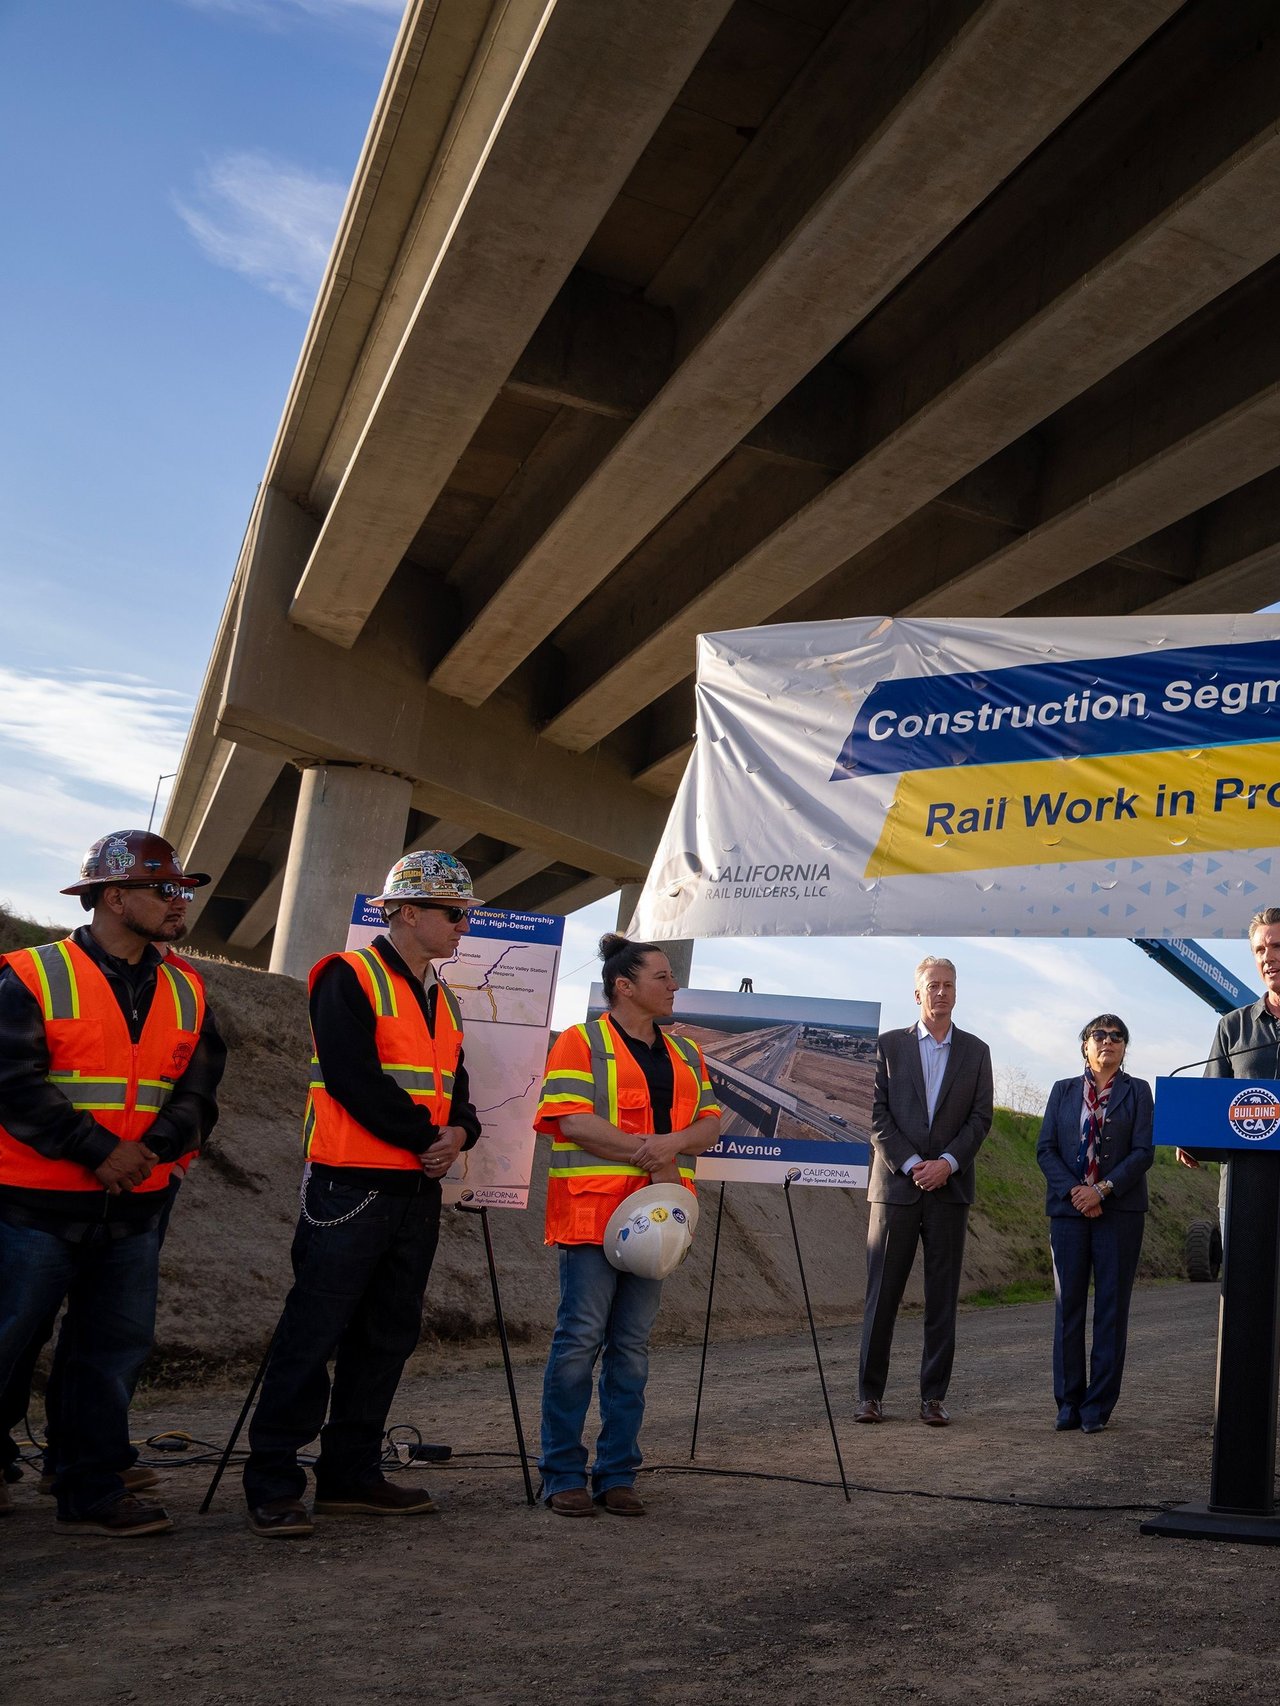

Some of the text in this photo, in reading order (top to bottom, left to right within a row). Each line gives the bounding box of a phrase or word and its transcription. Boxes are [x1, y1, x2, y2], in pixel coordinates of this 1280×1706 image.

[867, 688, 1147, 742] Construction
[925, 797, 1006, 838] Rail
[1022, 788, 1139, 828] Work
[1155, 783, 1196, 819] in
[705, 885, 829, 901] RAIL BUILDERS, LLC
[469, 917, 487, 927] Rail,
[488, 919, 535, 931] High-Desert
[473, 909, 508, 919] Network:
[509, 913, 555, 926] Partnership
[1167, 937, 1239, 998] quipmentShare
[1233, 1106, 1276, 1118] BUILDING
[1242, 1119, 1266, 1131] CA
[726, 1141, 782, 1156] Avenue
[803, 1168, 850, 1178] CALIFORNIA
[475, 1190, 519, 1199] CALIFORNIA
